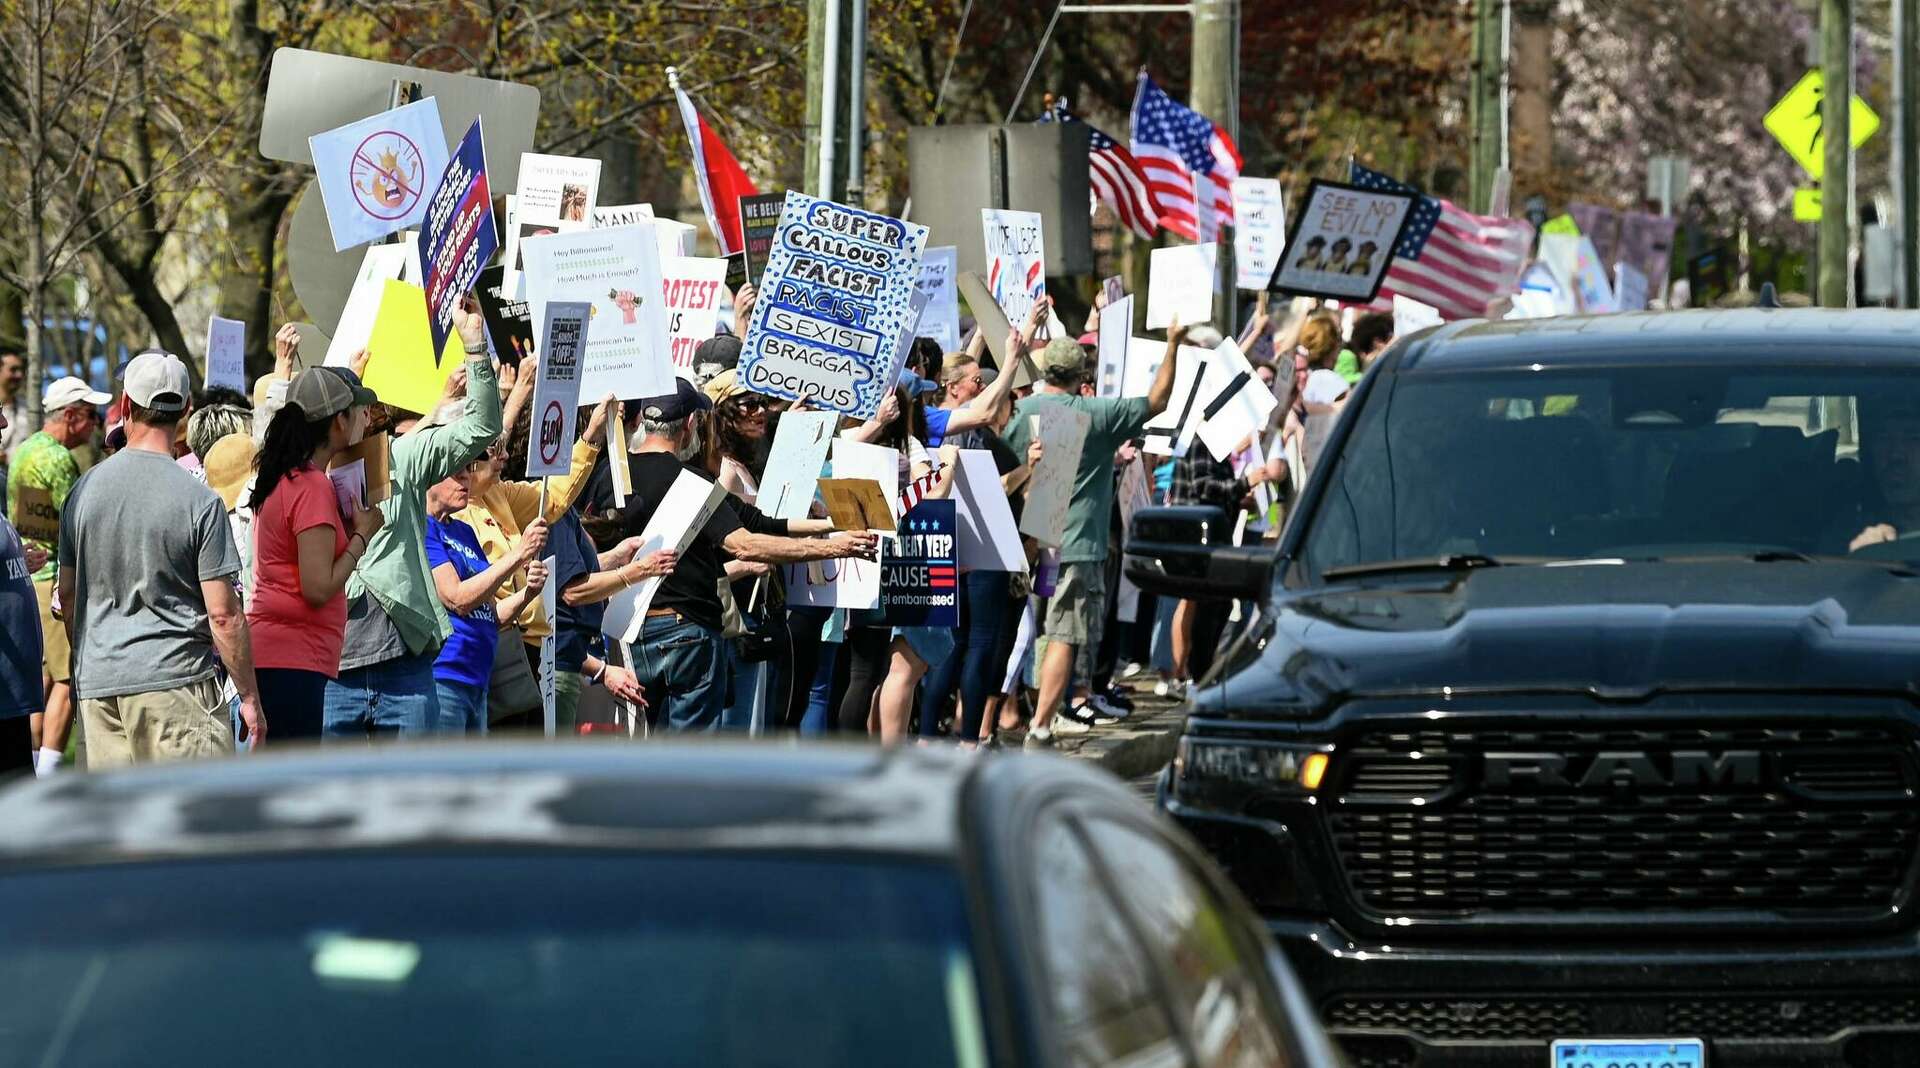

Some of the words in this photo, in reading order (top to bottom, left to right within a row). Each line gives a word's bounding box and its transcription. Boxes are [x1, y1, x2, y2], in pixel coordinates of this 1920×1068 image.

[430, 165, 463, 237] DEMOCRACY
[435, 179, 448, 207] THIS
[447, 156, 461, 183] THE
[428, 234, 438, 260] YOU
[436, 197, 455, 237] VOTED
[454, 168, 472, 202] FOR?
[592, 211, 648, 229] MAND
[745, 204, 758, 217] WE
[760, 202, 784, 217] BELIE
[1320, 192, 1358, 211] SEE
[1368, 199, 1397, 217] NO
[437, 228, 456, 272] STAND
[455, 209, 465, 233] UP
[814, 207, 901, 247] SUPER
[431, 277, 441, 310] FOR
[440, 244, 456, 282] YOUR
[455, 201, 481, 250] RIGHTS
[789, 230, 889, 269] CALLOUS
[438, 280, 456, 325] STAND
[455, 262, 464, 285] UP
[463, 237, 479, 268] FOR
[663, 278, 719, 310] ROTEST
[790, 258, 883, 297] FACIST
[777, 284, 875, 324] RACIST
[773, 312, 873, 352] SEXIST
[764, 338, 864, 376] BRAGGA-
[752, 364, 851, 406] DOCIOUS
[892, 535, 924, 558] GREAT
[925, 535, 953, 558] YET?
[891, 593, 955, 606] embarrassed
[1482, 751, 1761, 788] RAM
